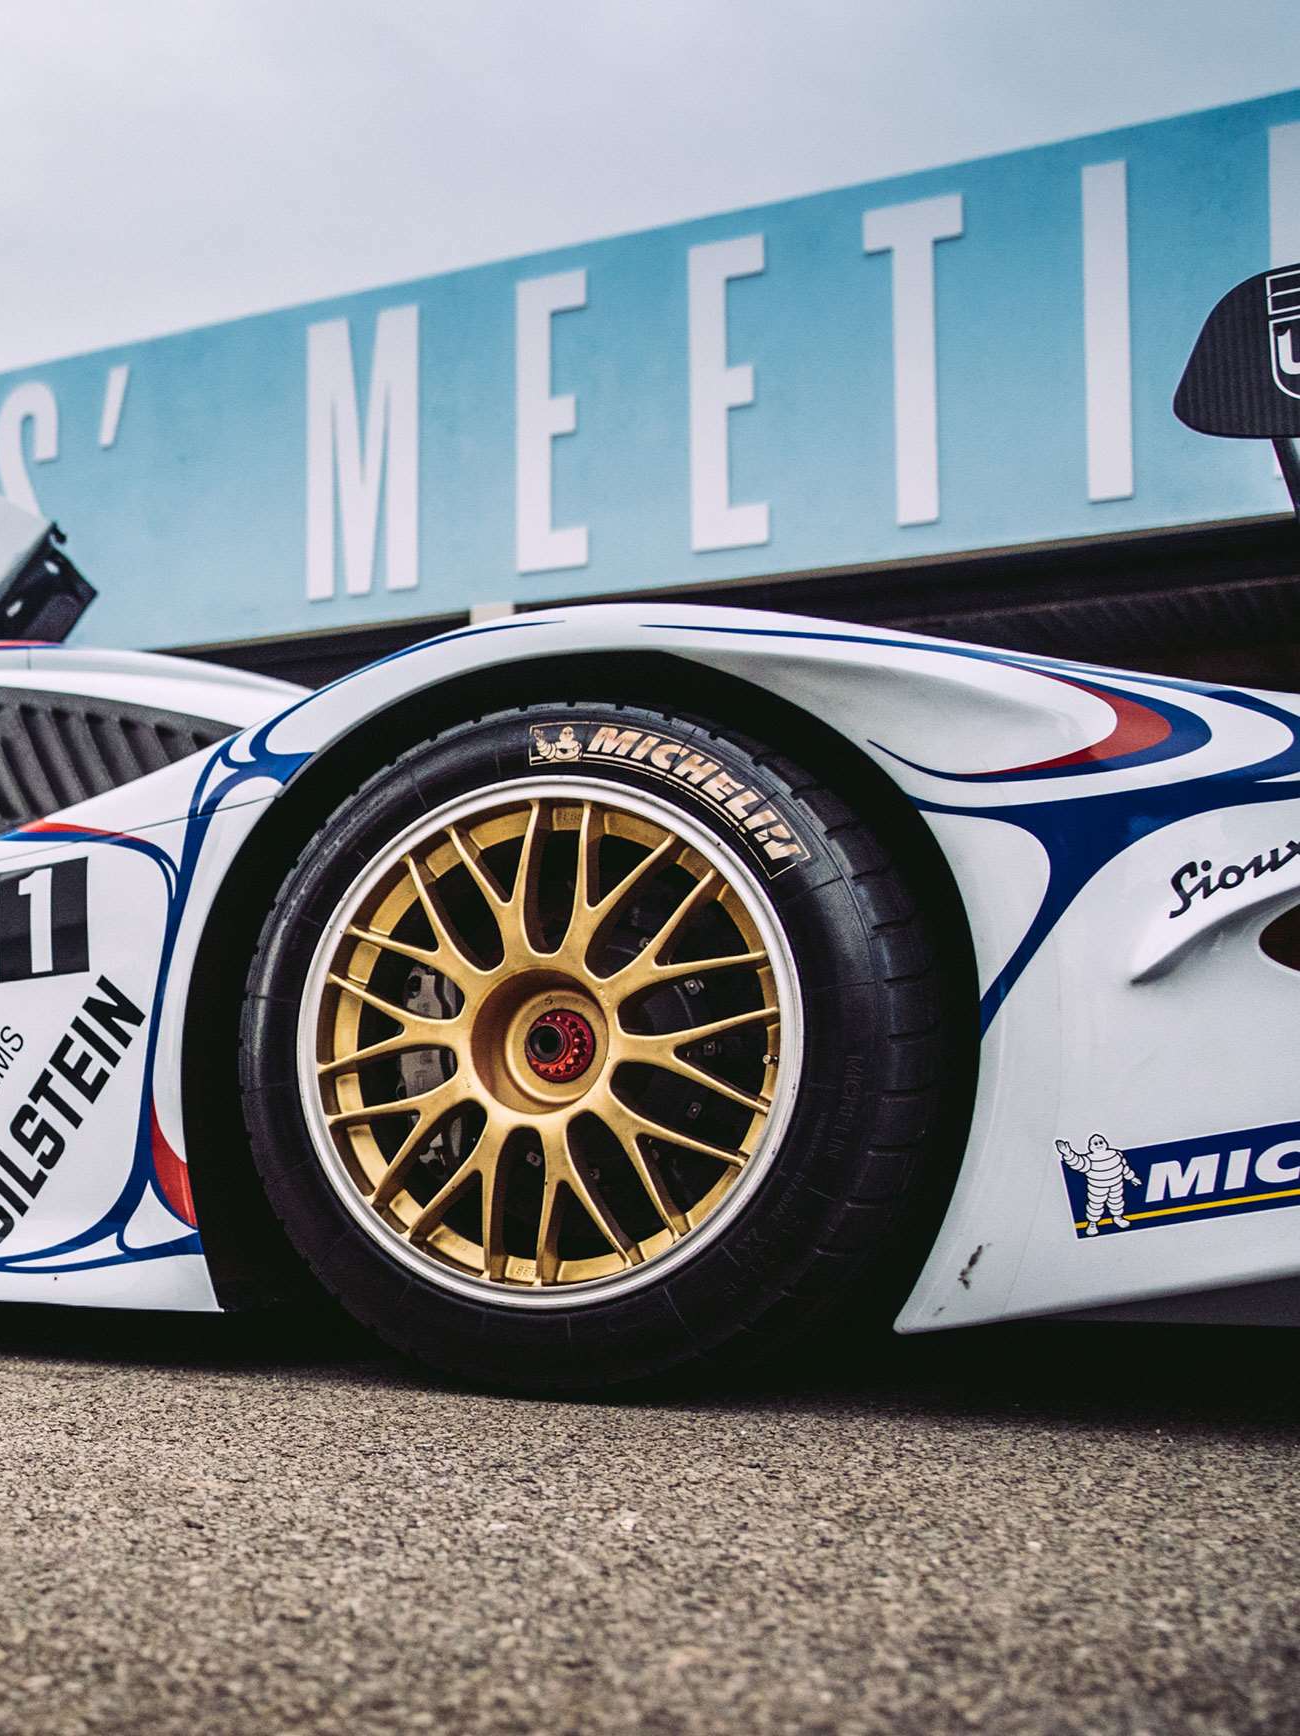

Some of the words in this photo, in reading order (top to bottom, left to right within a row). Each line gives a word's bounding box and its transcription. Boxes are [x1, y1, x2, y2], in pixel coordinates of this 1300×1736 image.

[306, 122, 1300, 604] MEETI
[586, 725, 802, 861] MICHELIN
[17, 867, 54, 974] 1
